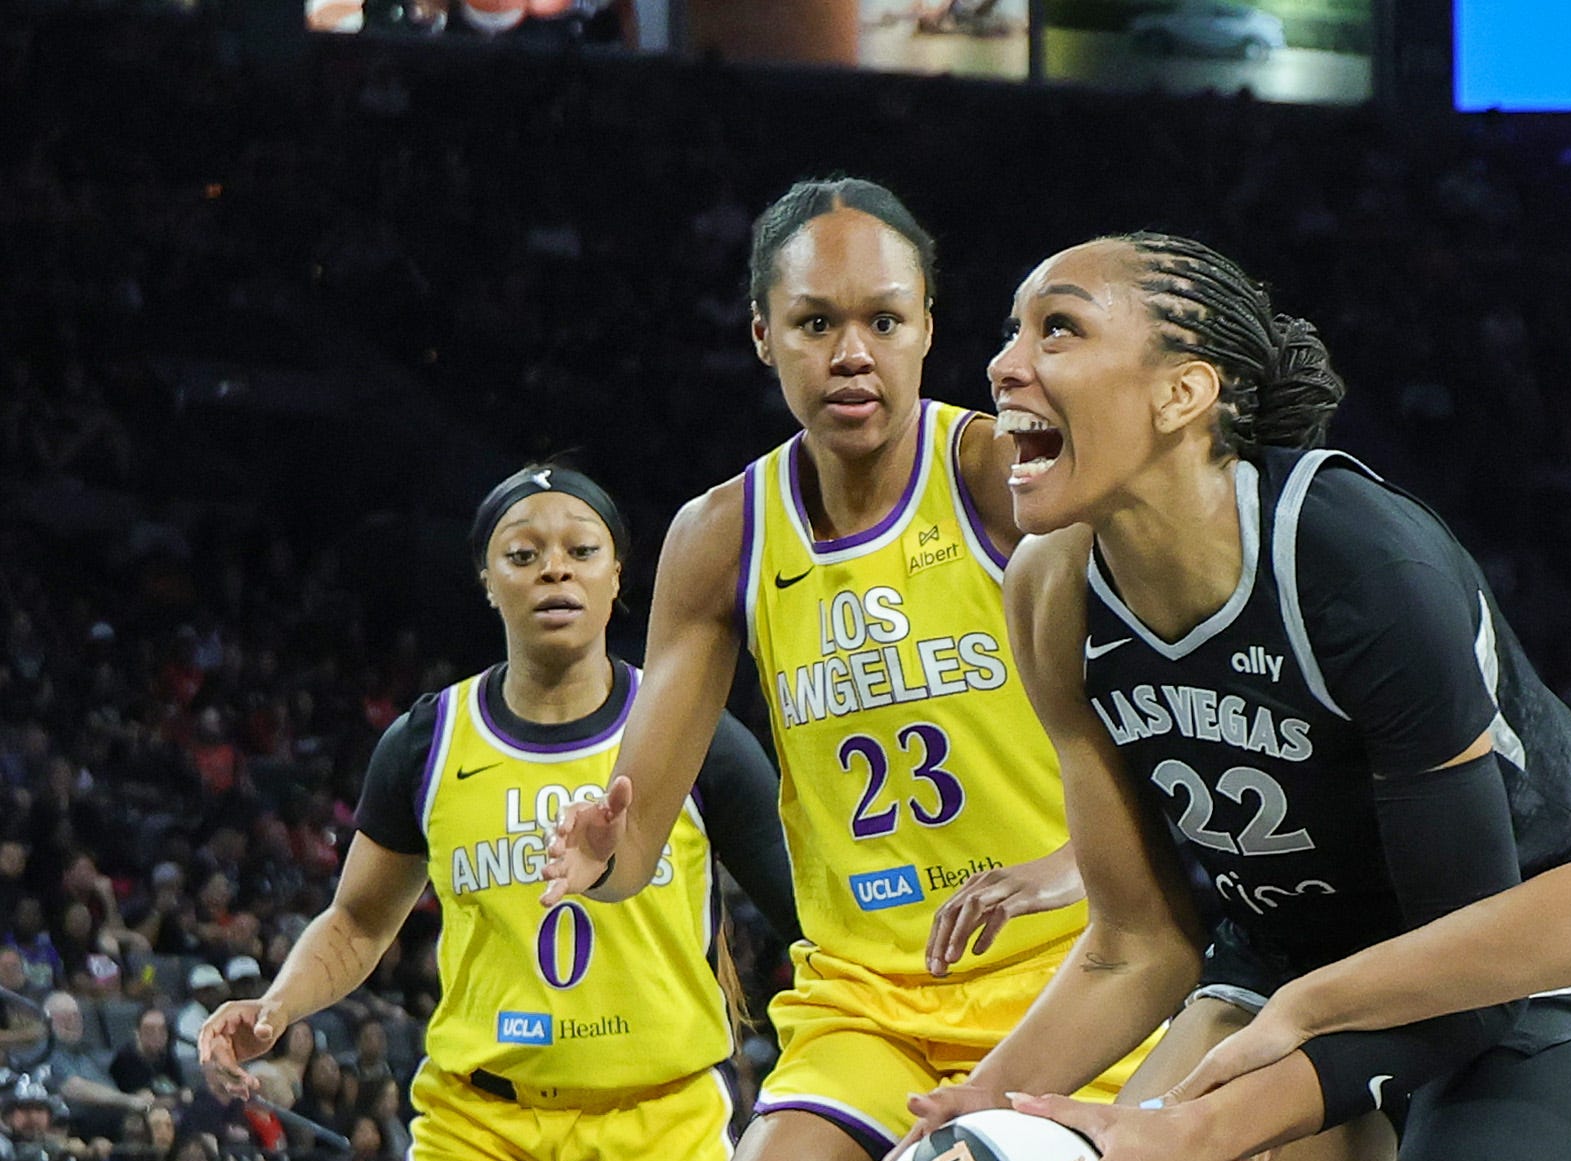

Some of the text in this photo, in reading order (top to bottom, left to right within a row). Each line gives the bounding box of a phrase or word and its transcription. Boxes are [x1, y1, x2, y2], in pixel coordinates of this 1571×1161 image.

[908, 543, 960, 571] Albert
[818, 586, 911, 657] LOS
[776, 632, 1008, 729] ANGELES
[1231, 646, 1284, 682] ally
[1090, 684, 1314, 762] LAS VEGAS
[837, 721, 965, 841] 23
[1150, 759, 1316, 857] 22
[452, 834, 674, 896] ANGS
[856, 876, 914, 902] UCLA
[534, 900, 595, 990] 0
[503, 1015, 630, 1039] UCLA Health
